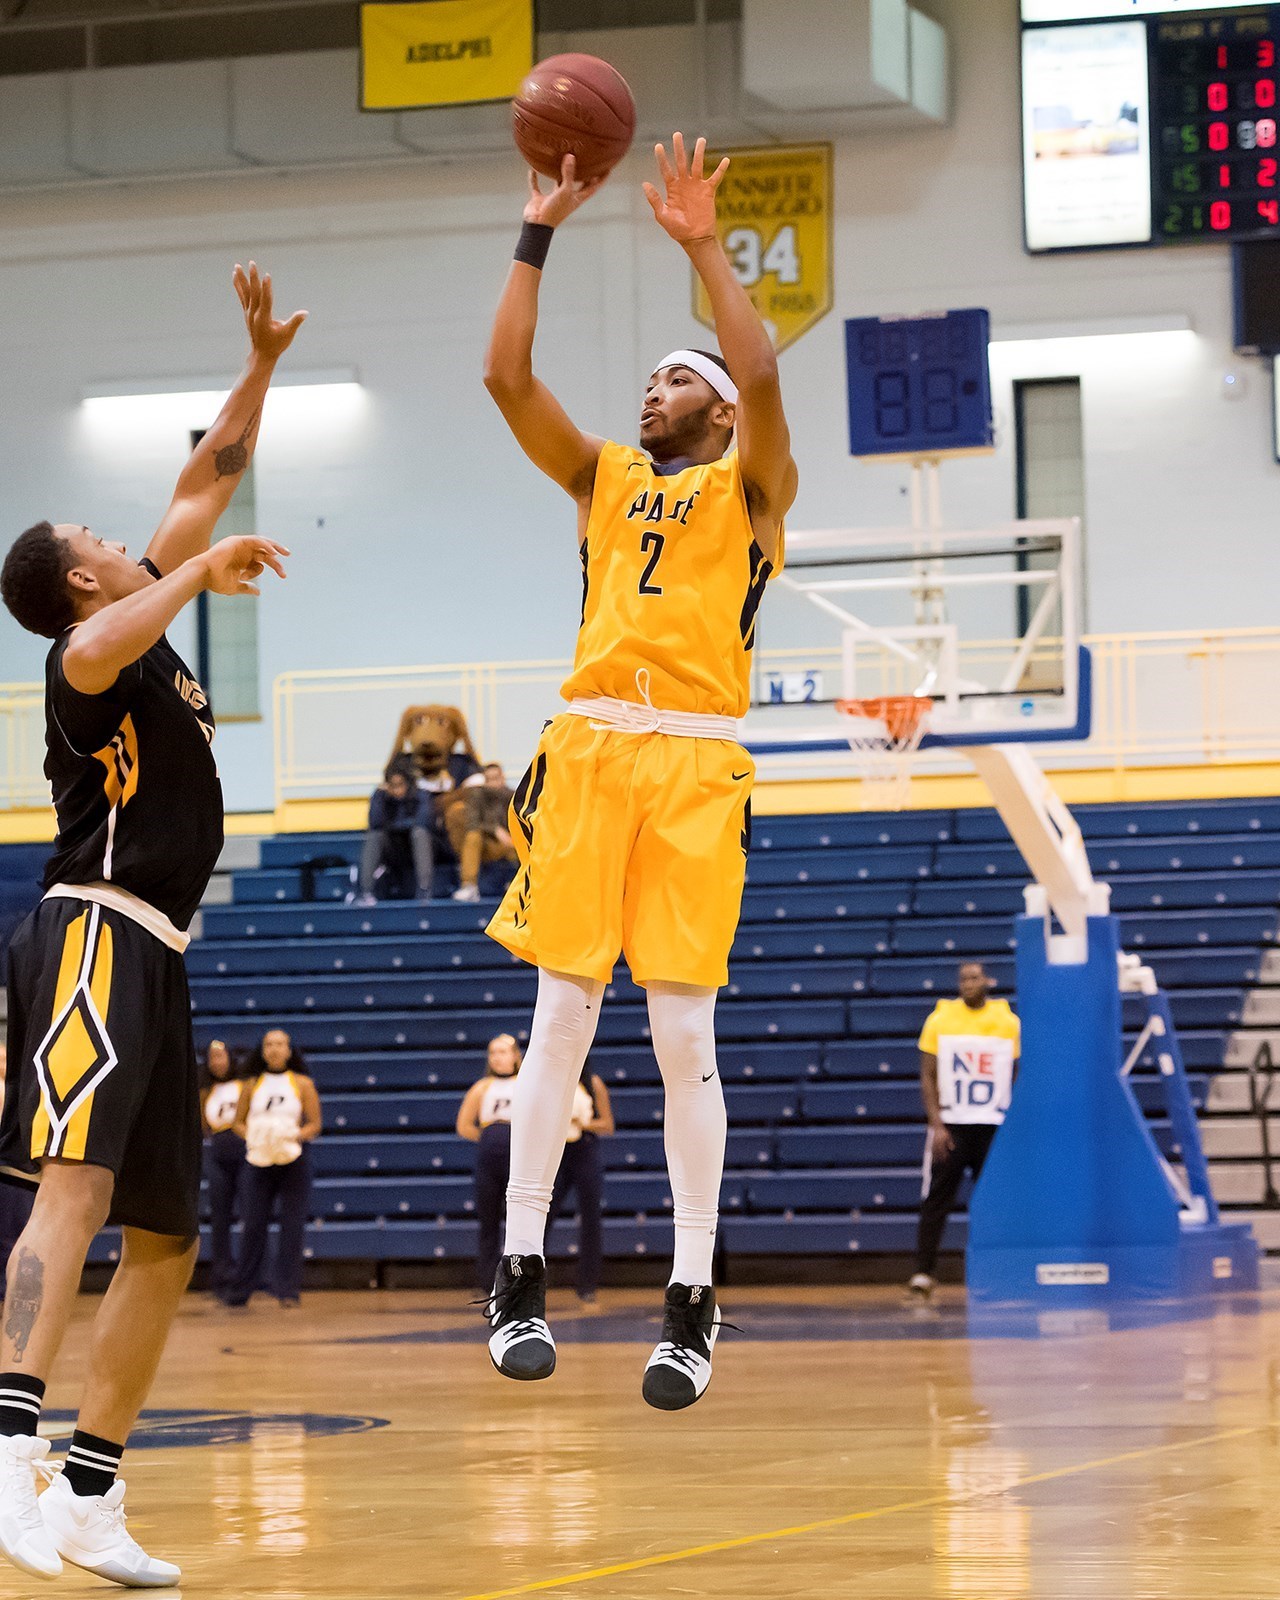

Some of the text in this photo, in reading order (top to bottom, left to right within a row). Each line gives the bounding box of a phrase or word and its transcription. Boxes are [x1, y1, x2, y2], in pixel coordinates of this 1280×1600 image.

[406, 36, 491, 64] ADELPHI
[1217, 45, 1228, 69] 1
[1257, 40, 1275, 68] 3
[712, 174, 815, 196] ENNIFER
[1219, 164, 1230, 188] 1
[1257, 158, 1278, 187] 2
[716, 197, 823, 218] MAGGIO
[1257, 200, 1278, 225] 4
[725, 225, 799, 287] 34
[638, 531, 664, 596] 2
[952, 1051, 994, 1076] NE
[265, 1095, 286, 1112] P
[955, 1079, 995, 1106] 10
[493, 1098, 512, 1114] P
